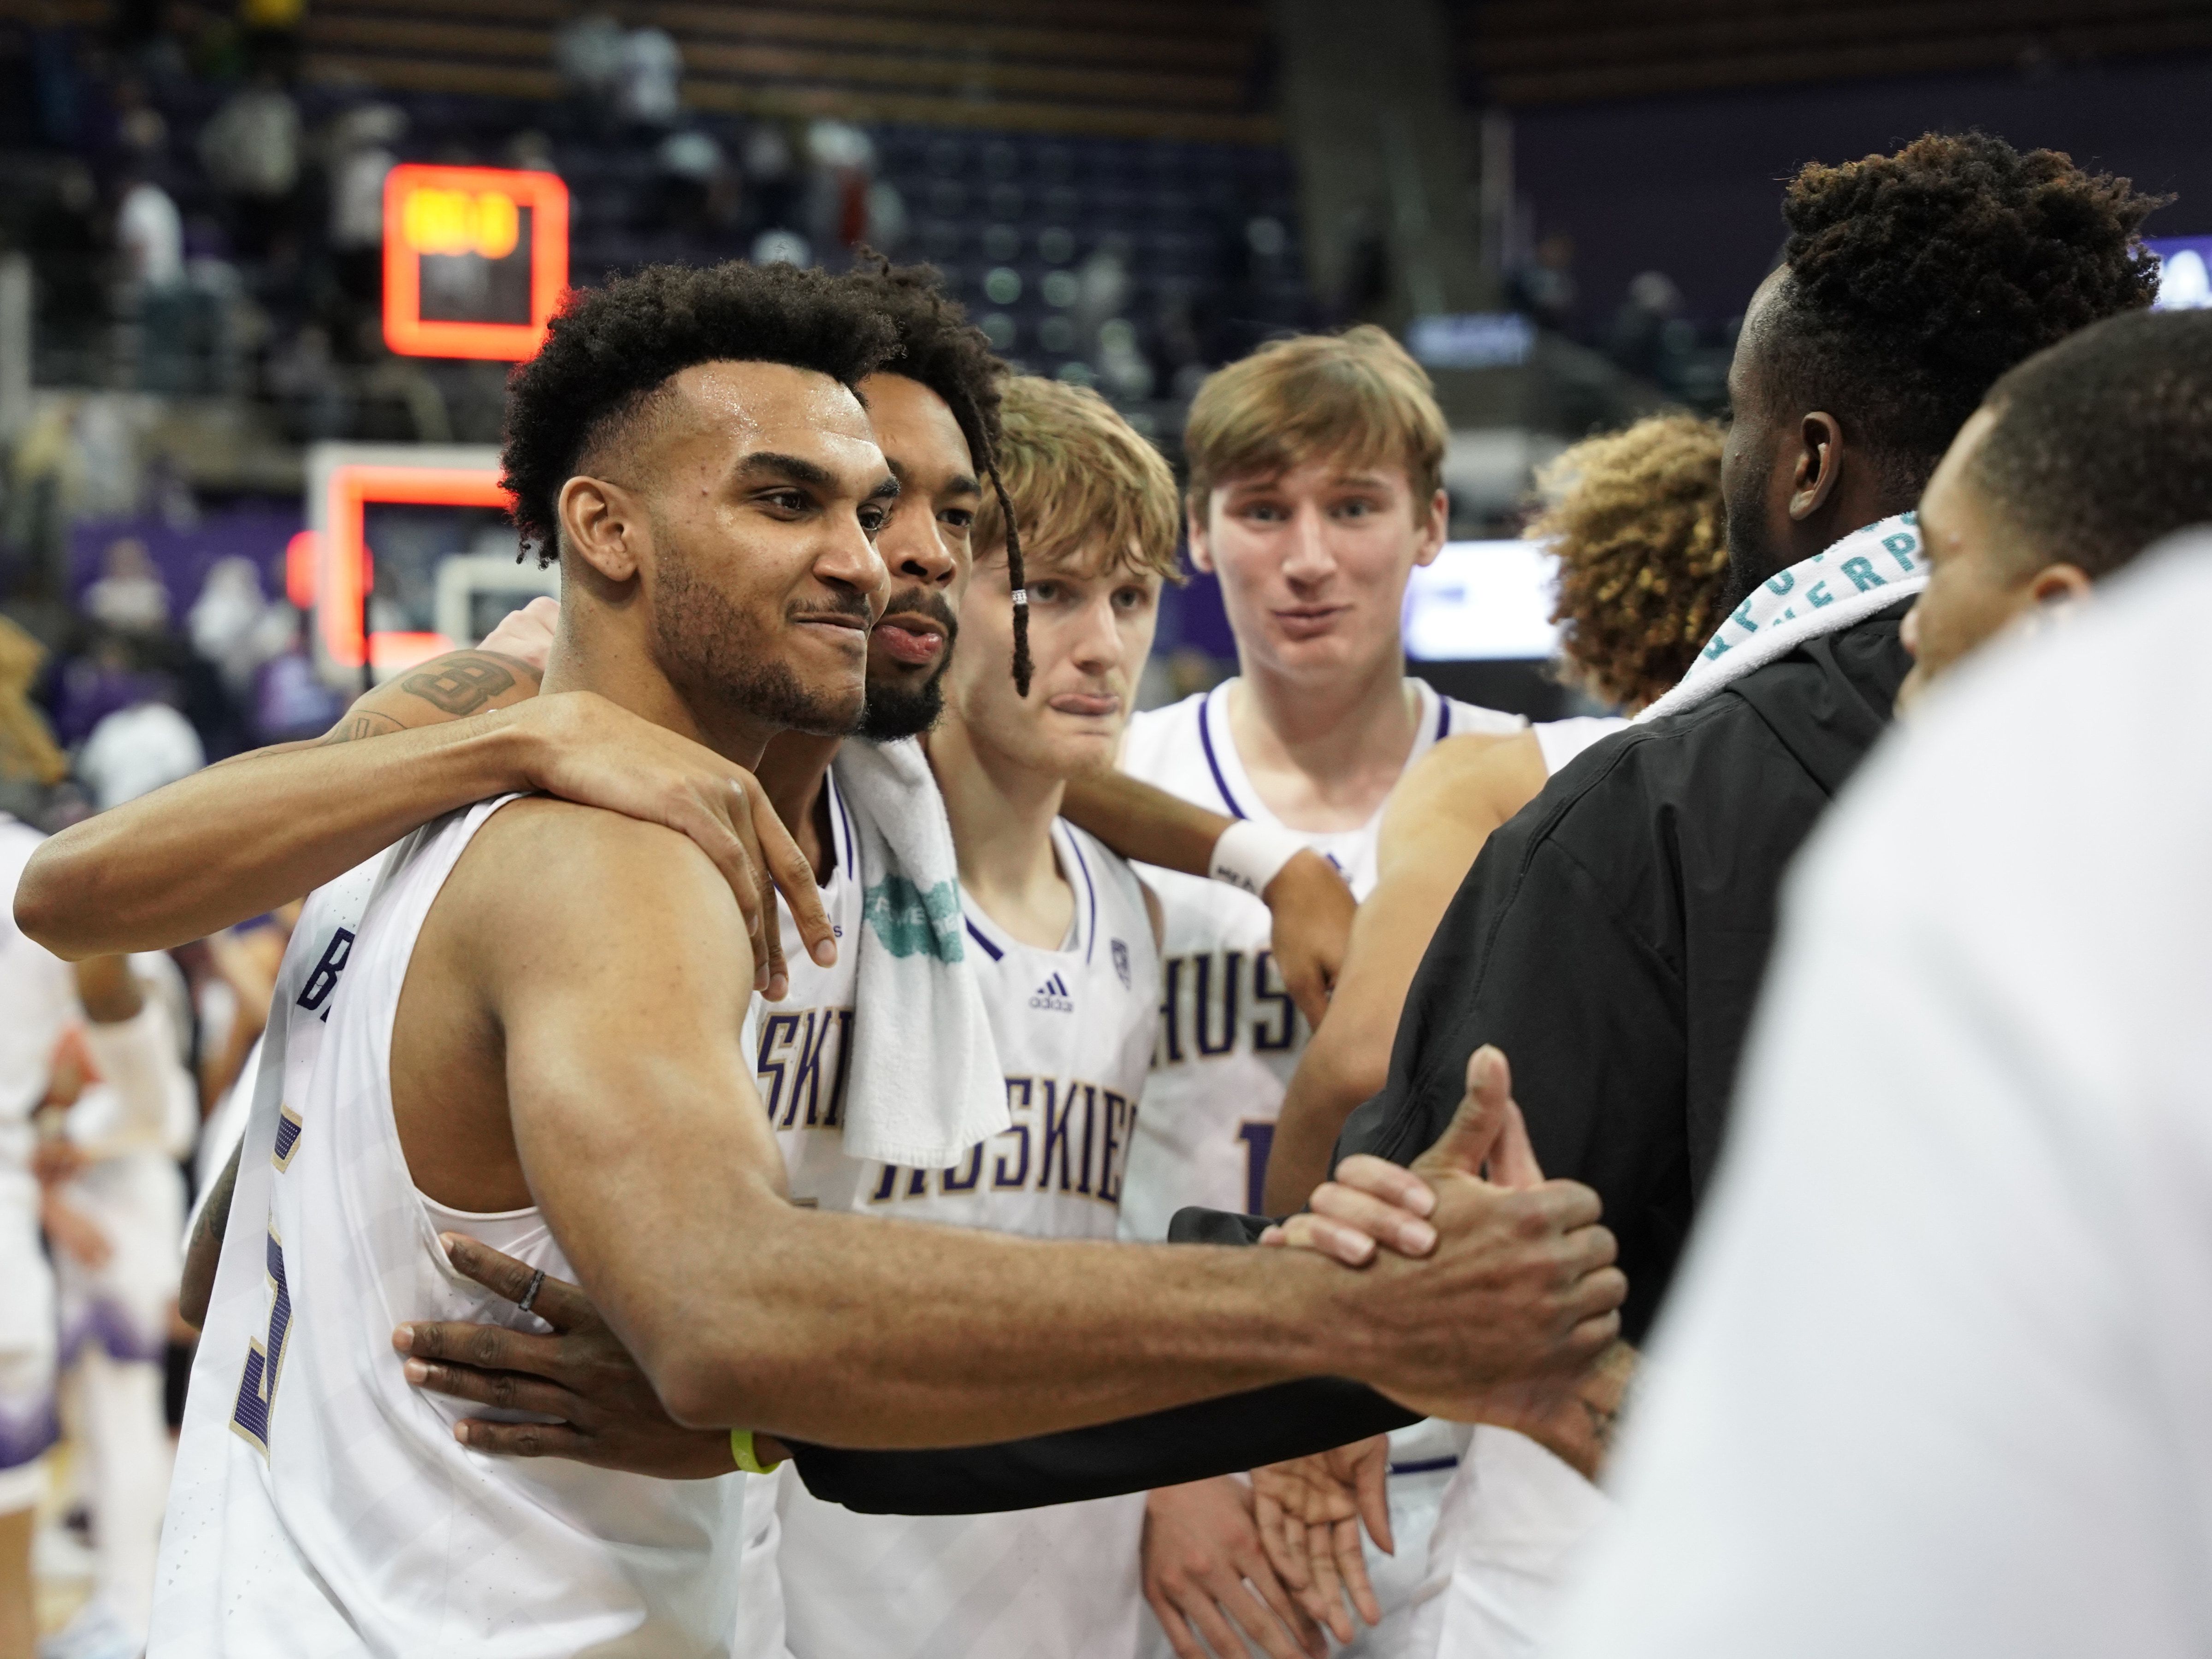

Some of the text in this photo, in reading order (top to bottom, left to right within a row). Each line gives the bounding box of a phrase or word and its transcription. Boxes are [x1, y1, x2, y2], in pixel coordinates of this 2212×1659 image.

[296, 926, 355, 1023] B
[757, 1006, 856, 1132] SKI
[869, 1075, 1138, 1210] SKIE
